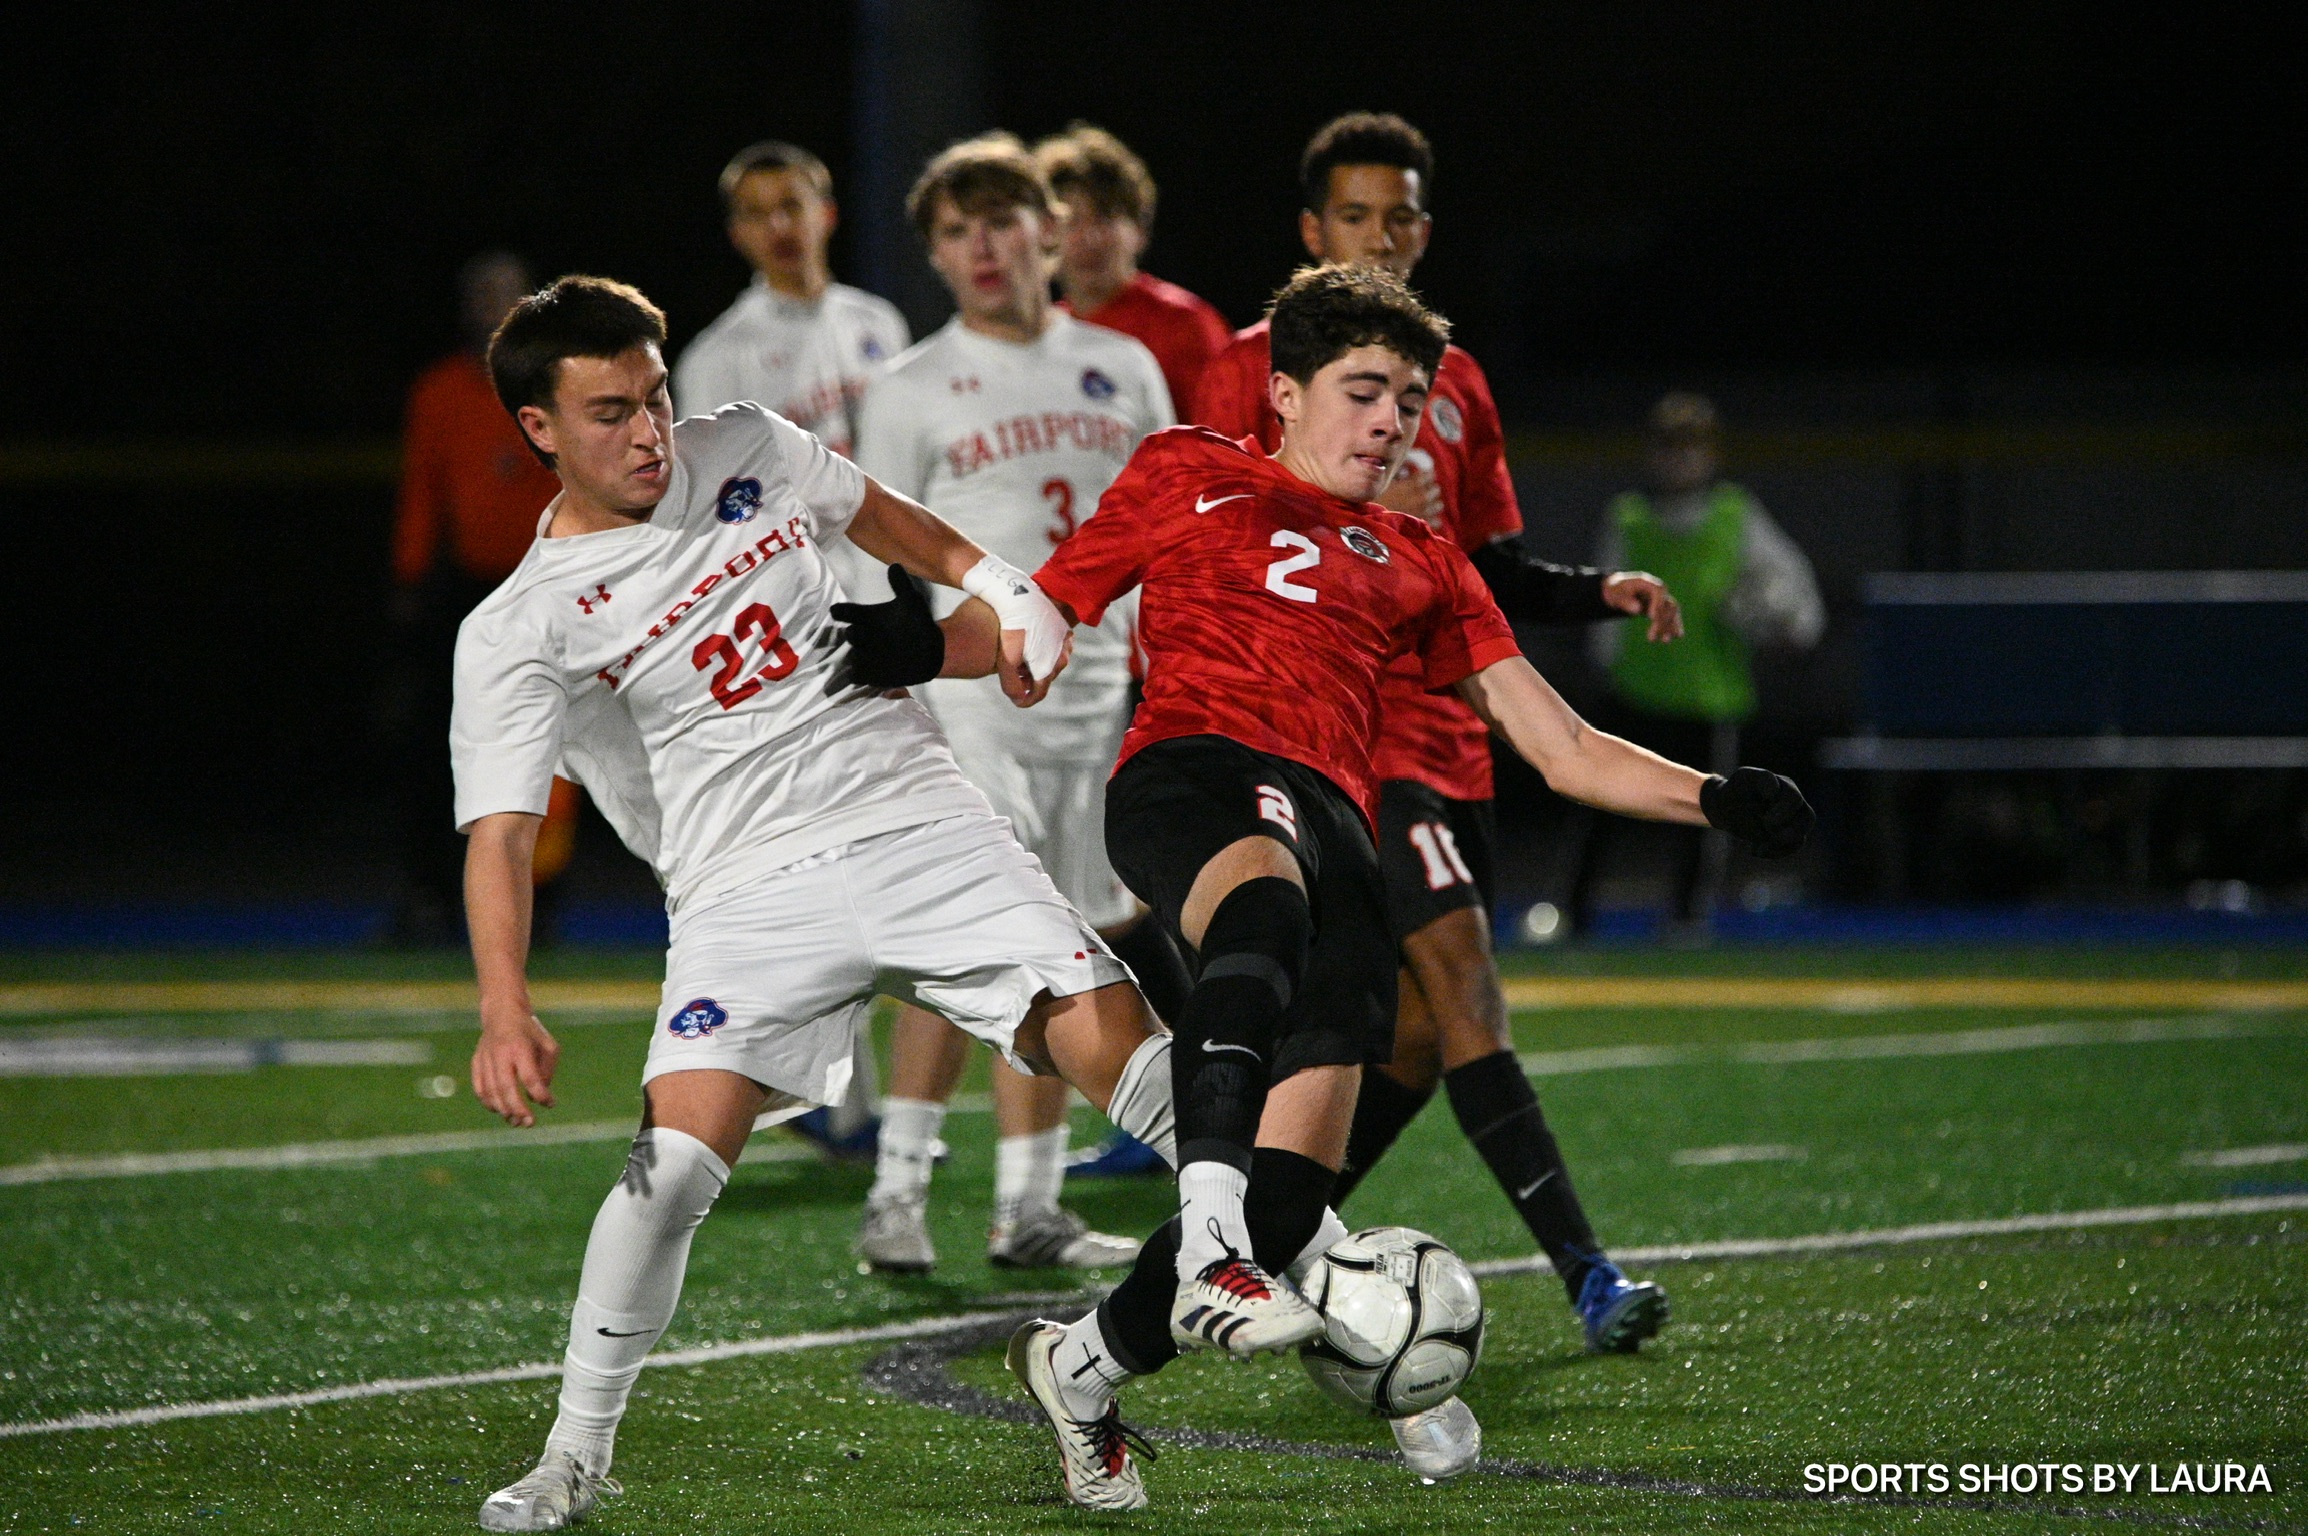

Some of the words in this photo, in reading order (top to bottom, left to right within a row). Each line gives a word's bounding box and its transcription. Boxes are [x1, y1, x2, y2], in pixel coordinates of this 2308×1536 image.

[1041, 474, 1078, 545] 3
[1265, 529, 1320, 603] 2
[691, 602, 799, 711] 23
[1255, 784, 1298, 843] 2
